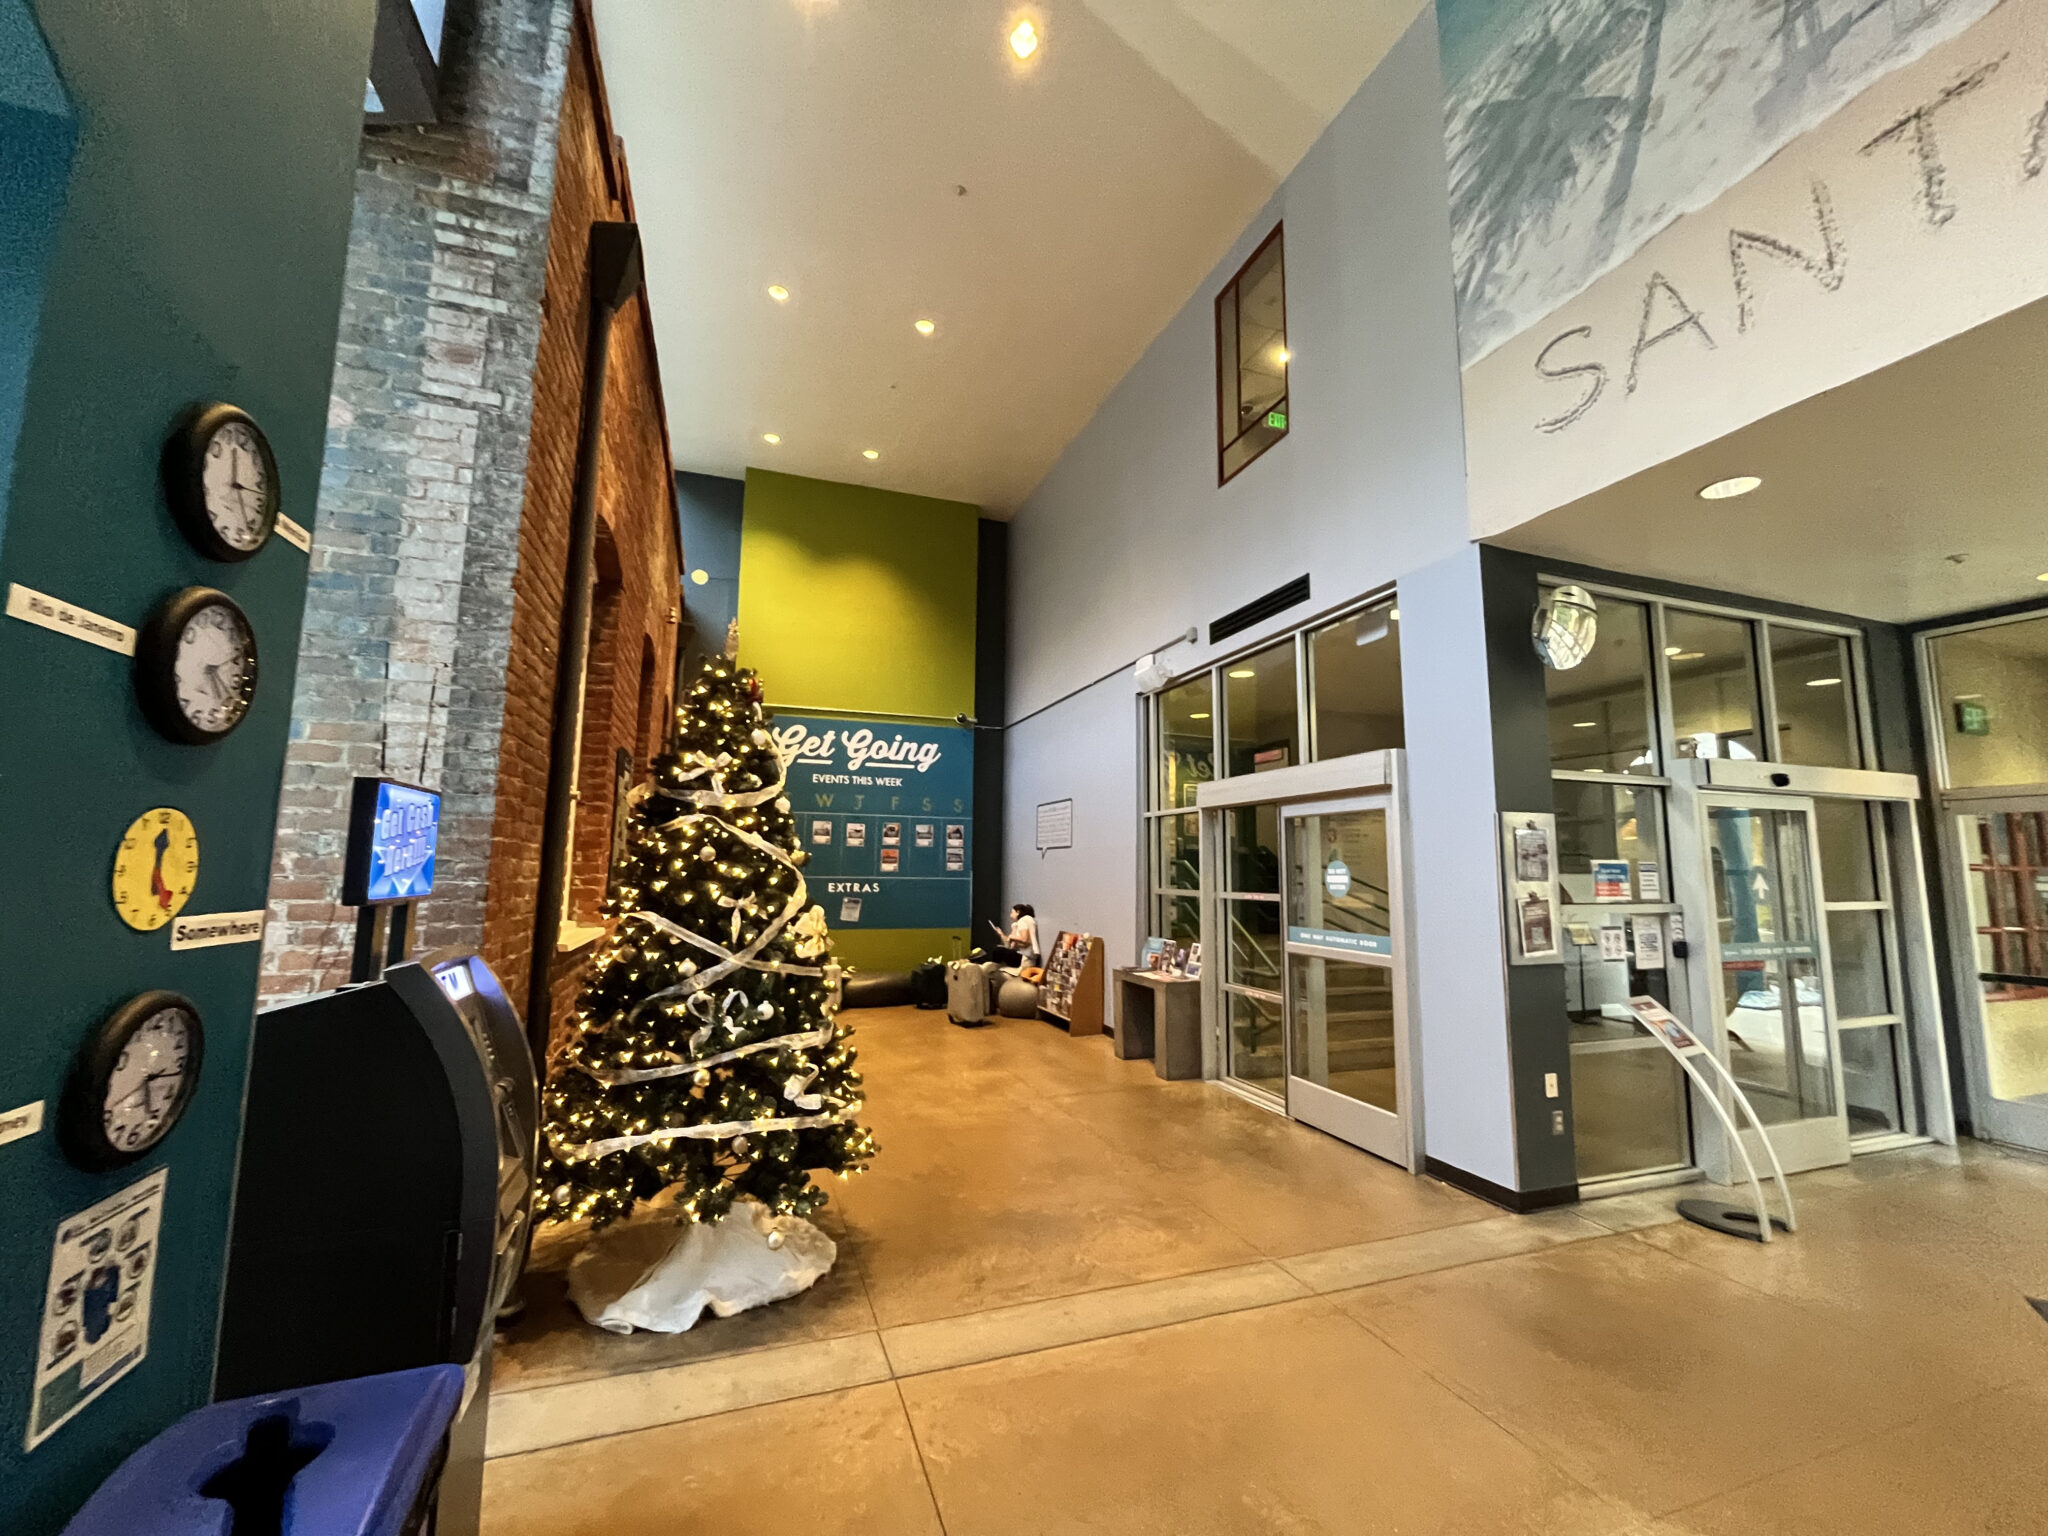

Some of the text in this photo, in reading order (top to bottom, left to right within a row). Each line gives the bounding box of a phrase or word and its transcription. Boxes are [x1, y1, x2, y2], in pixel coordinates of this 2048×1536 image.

[772, 724, 941, 773] Get Going
[812, 774, 903, 787] EVENTS THIS WEEK
[815, 793, 834, 808] W
[891, 796, 900, 811] F
[922, 798, 932, 812] S
[828, 883, 880, 893] EXTRAS
[176, 920, 259, 941] Somewhere
